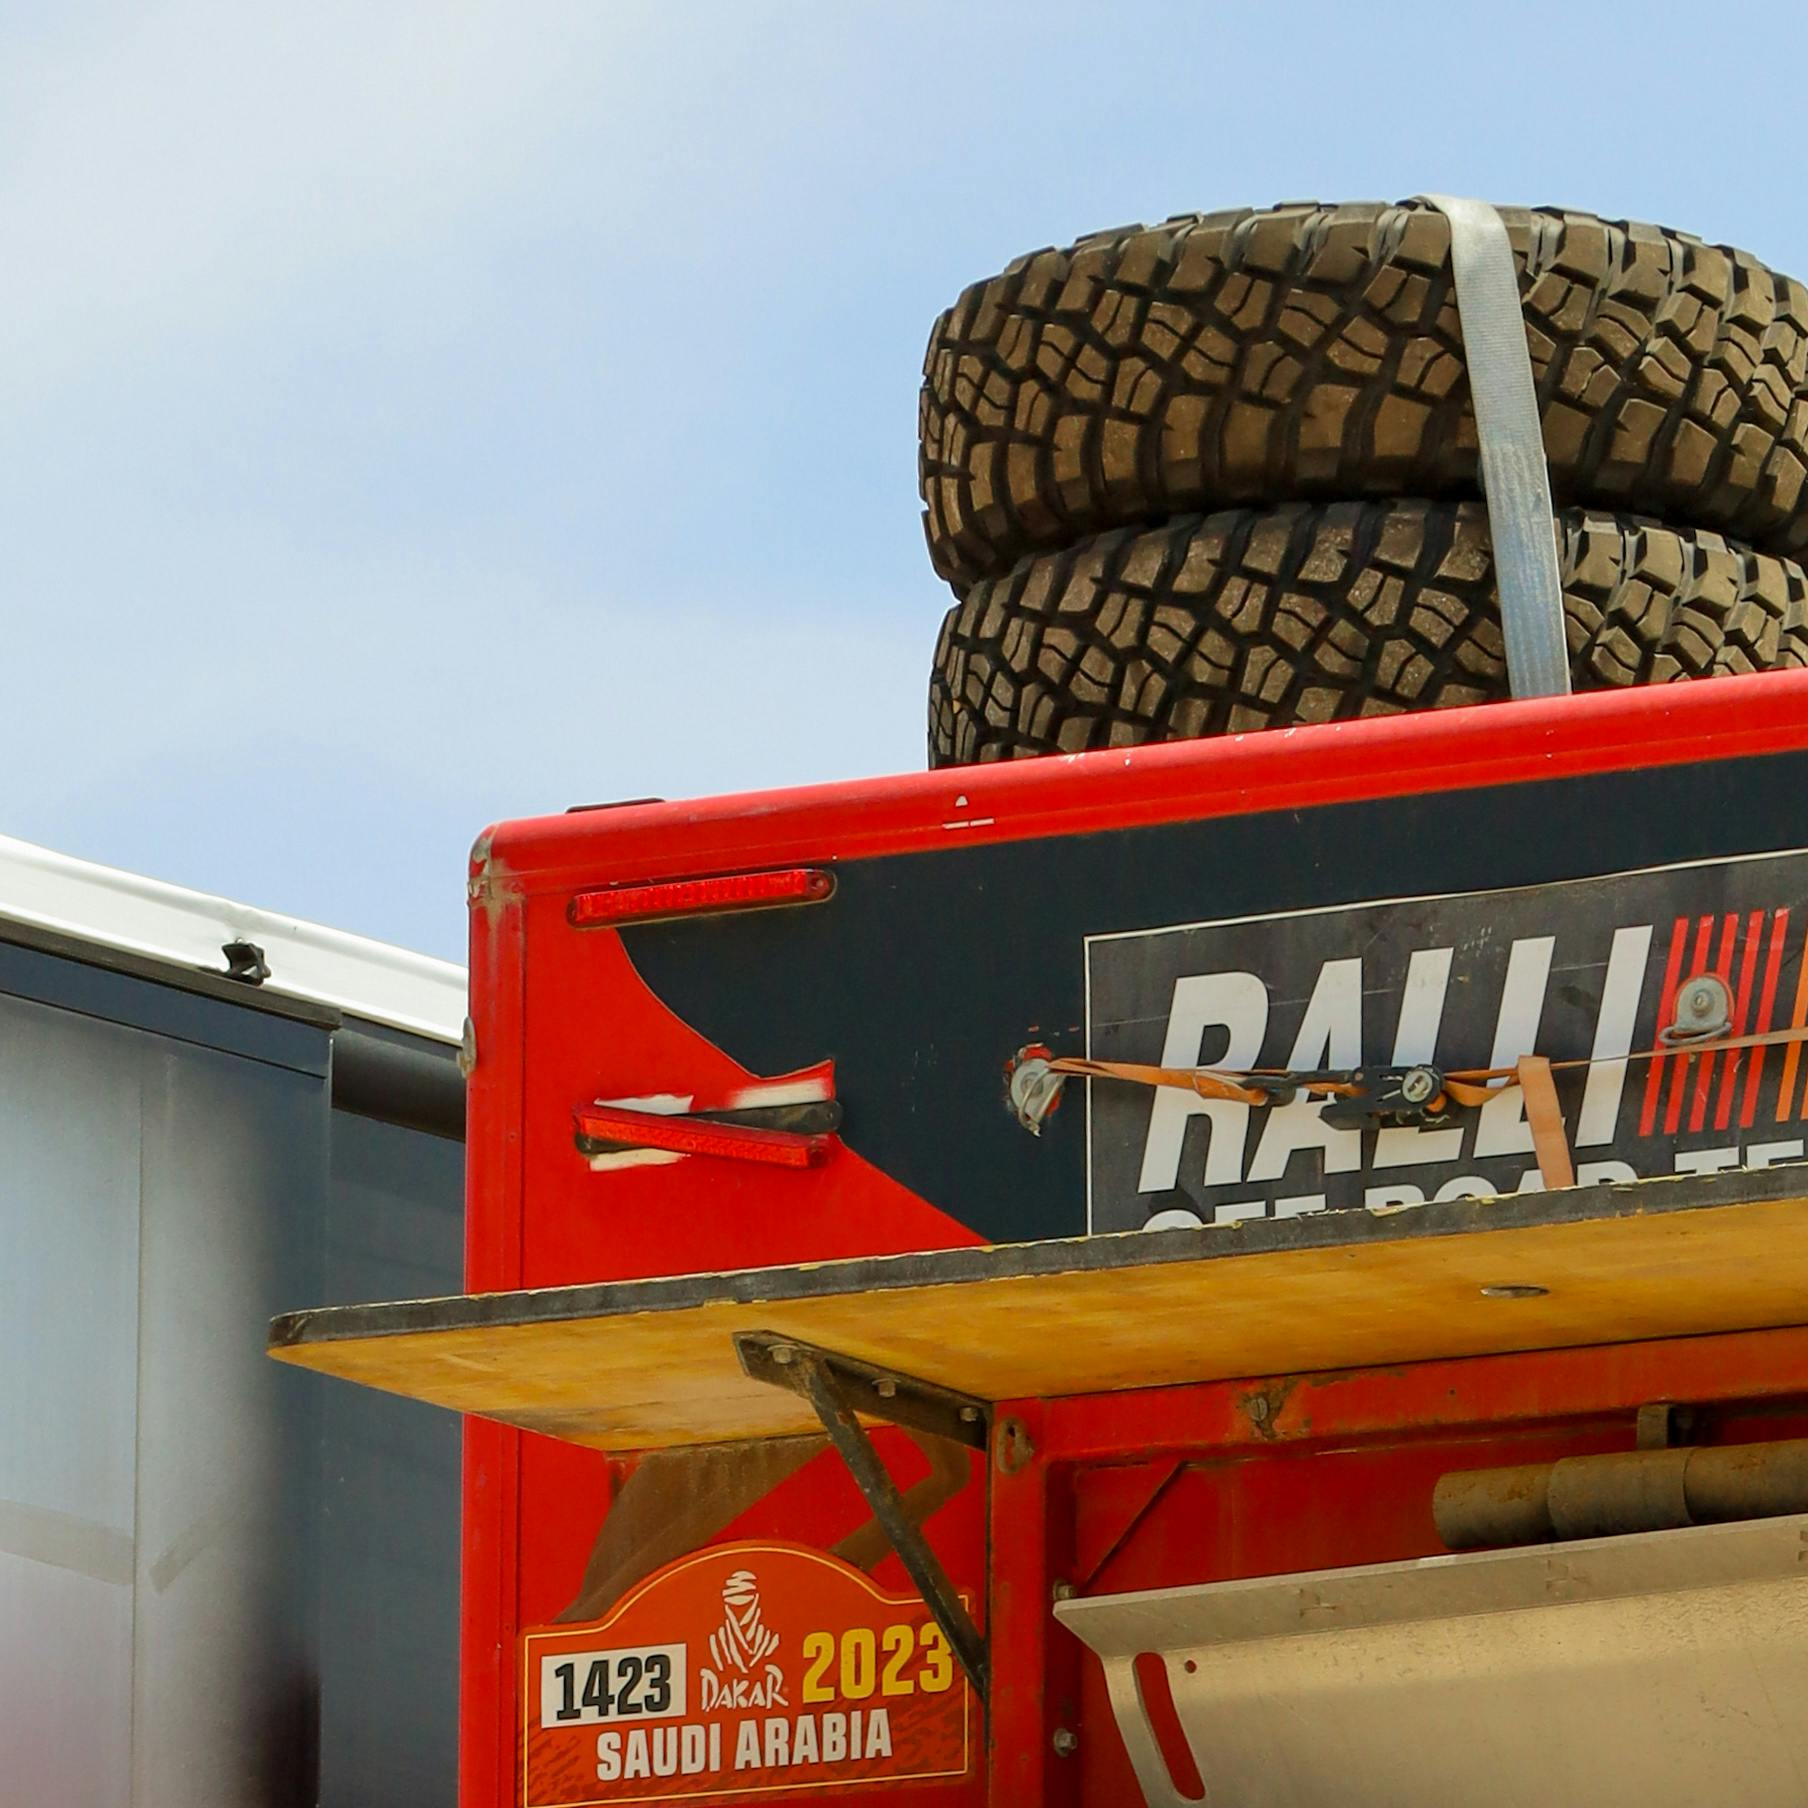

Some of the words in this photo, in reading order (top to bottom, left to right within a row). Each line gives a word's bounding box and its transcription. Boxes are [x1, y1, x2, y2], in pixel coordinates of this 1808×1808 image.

[1138, 925, 1653, 1193] RALLI
[554, 1654, 672, 1720] 1423
[700, 1664, 789, 1713] DAKAR
[803, 1621, 954, 1704] 2023
[597, 1722, 721, 1782] SAUDI
[735, 1708, 892, 1770] ARABIA
